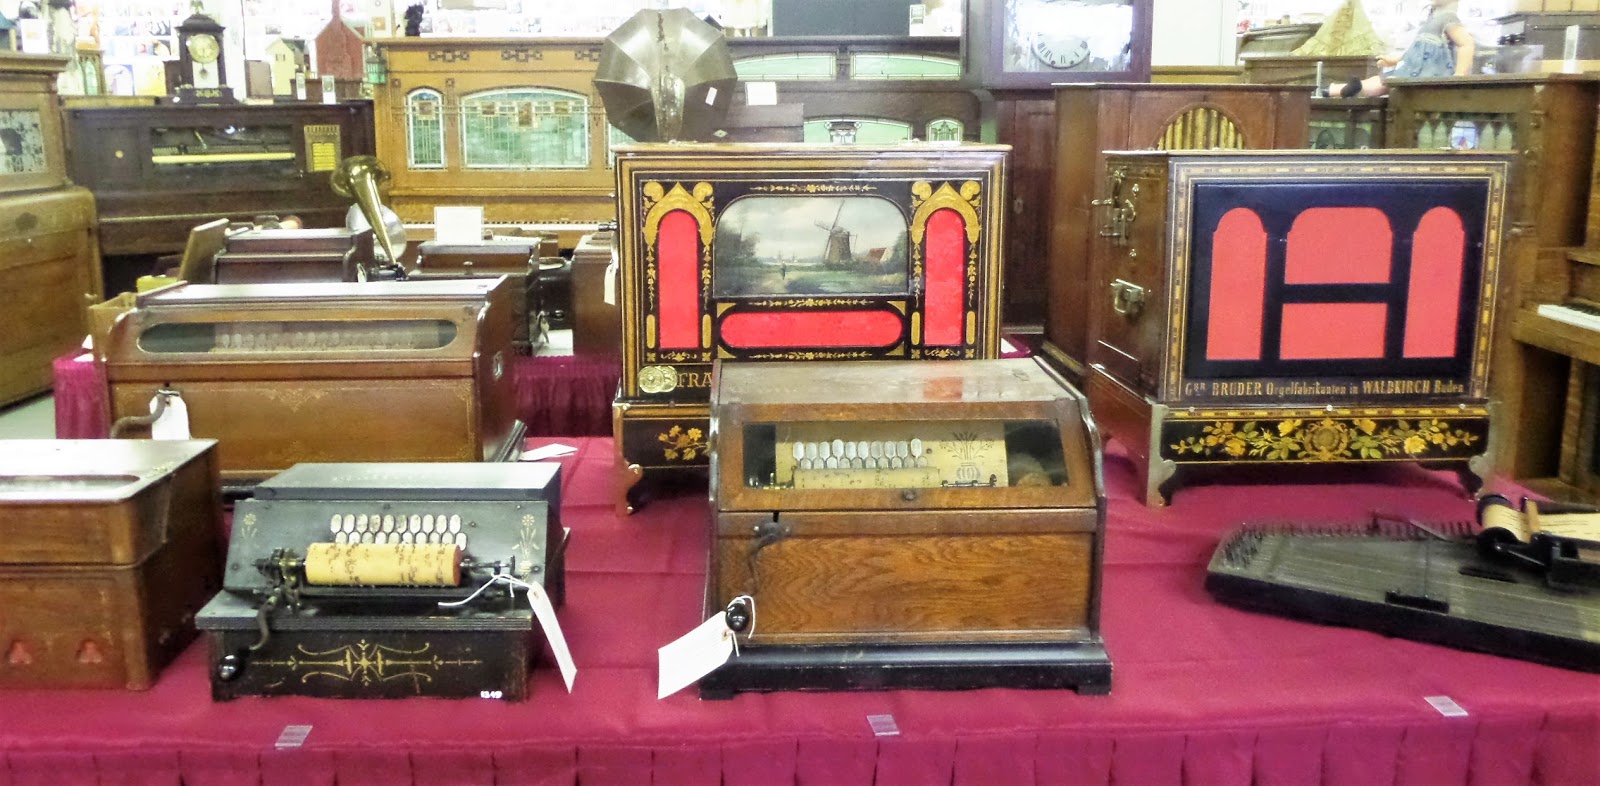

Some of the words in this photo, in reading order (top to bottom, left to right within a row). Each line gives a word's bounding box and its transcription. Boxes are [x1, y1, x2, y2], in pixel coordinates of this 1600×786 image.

[1212, 382, 1263, 396] BRUDER
[1266, 381, 1346, 398] Orgelfabrikanten
[1349, 383, 1359, 395] in
[1362, 380, 1431, 395] WALDKIRCH
